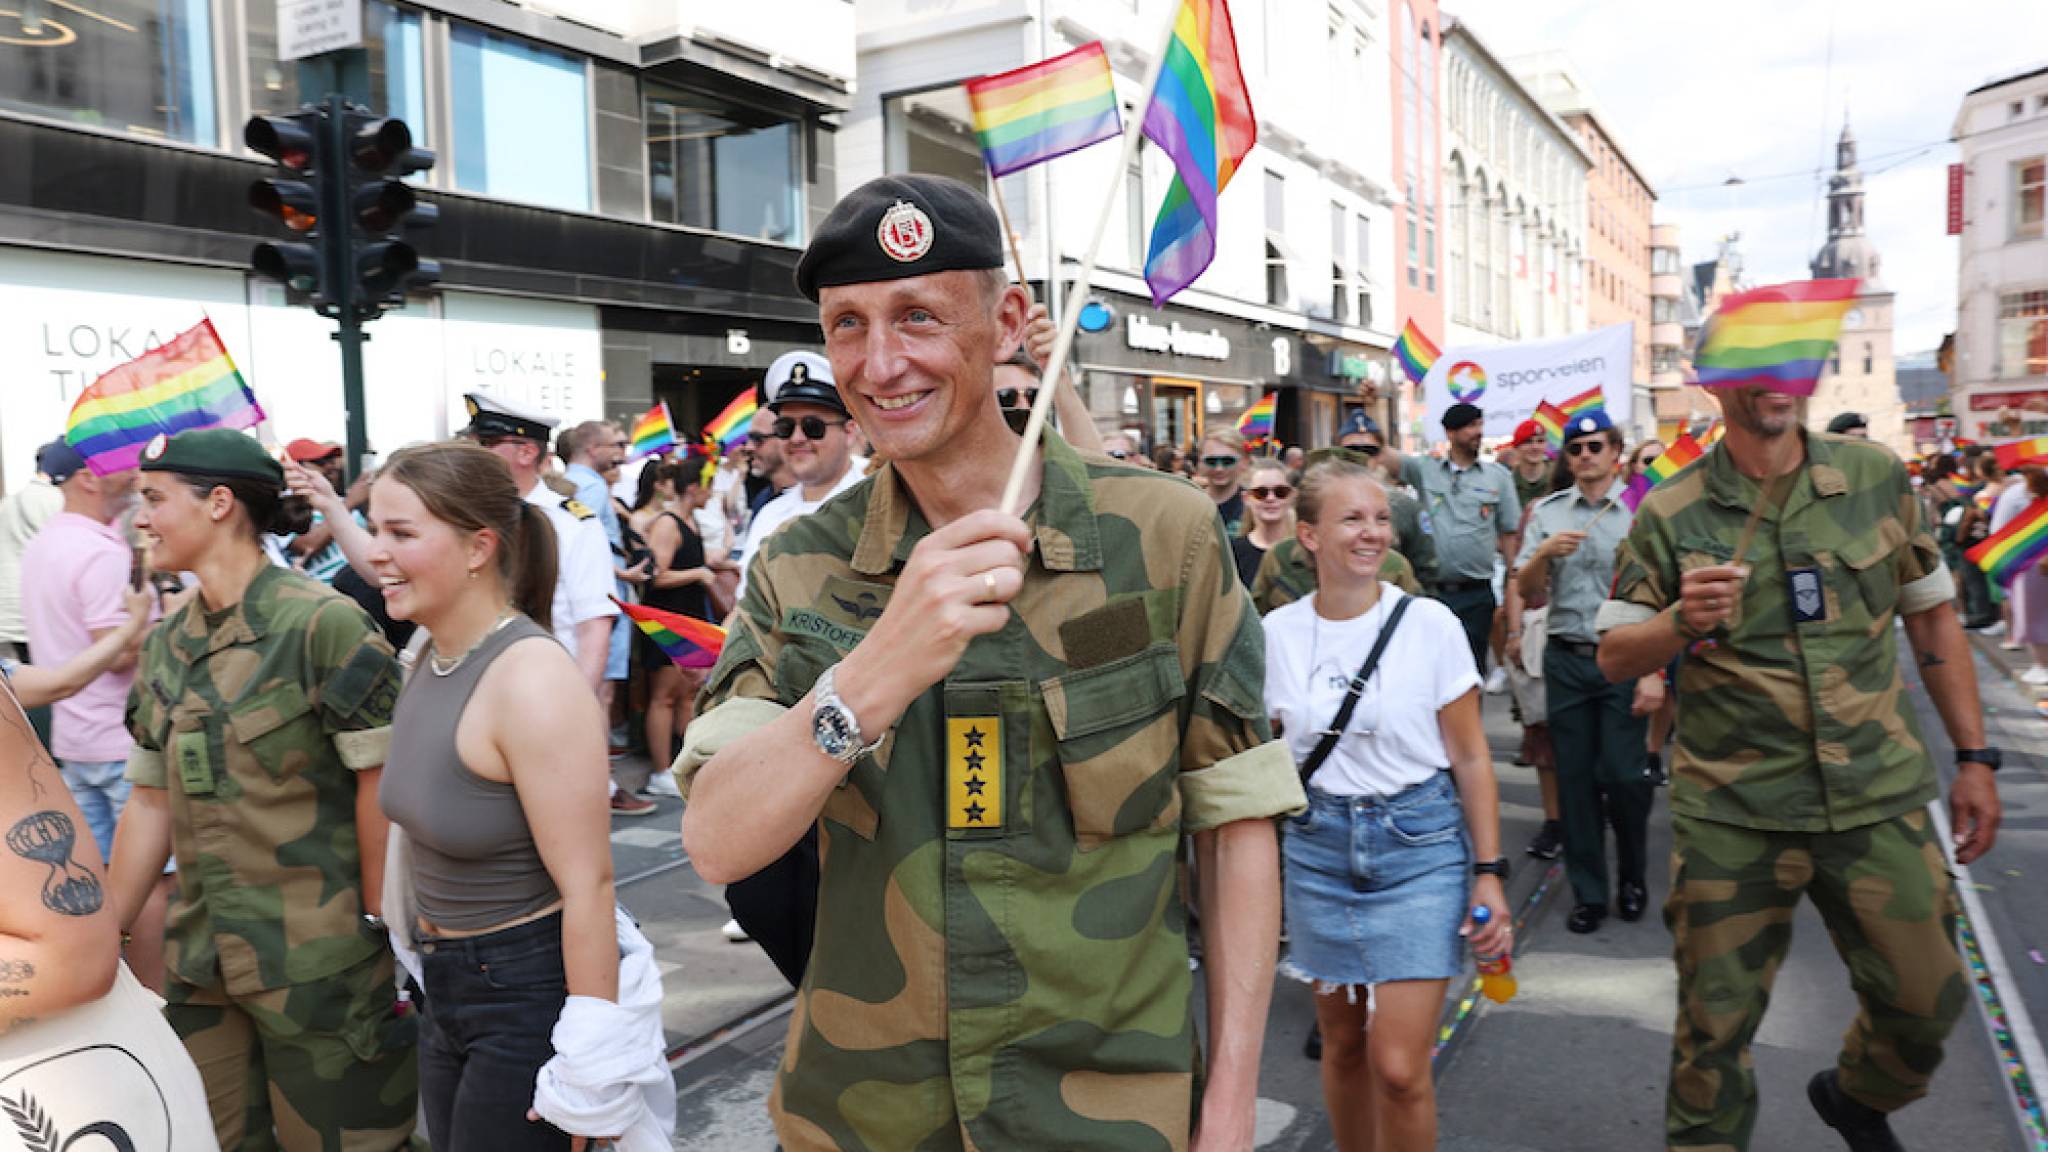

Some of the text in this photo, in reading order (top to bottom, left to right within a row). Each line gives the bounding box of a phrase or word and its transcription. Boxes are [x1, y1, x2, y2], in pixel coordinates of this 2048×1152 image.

[43, 323, 165, 358] LOKA
[473, 347, 575, 377] LOKALE
[1496, 357, 1605, 391] sporveien
[787, 610, 866, 647] KRISTOFF
